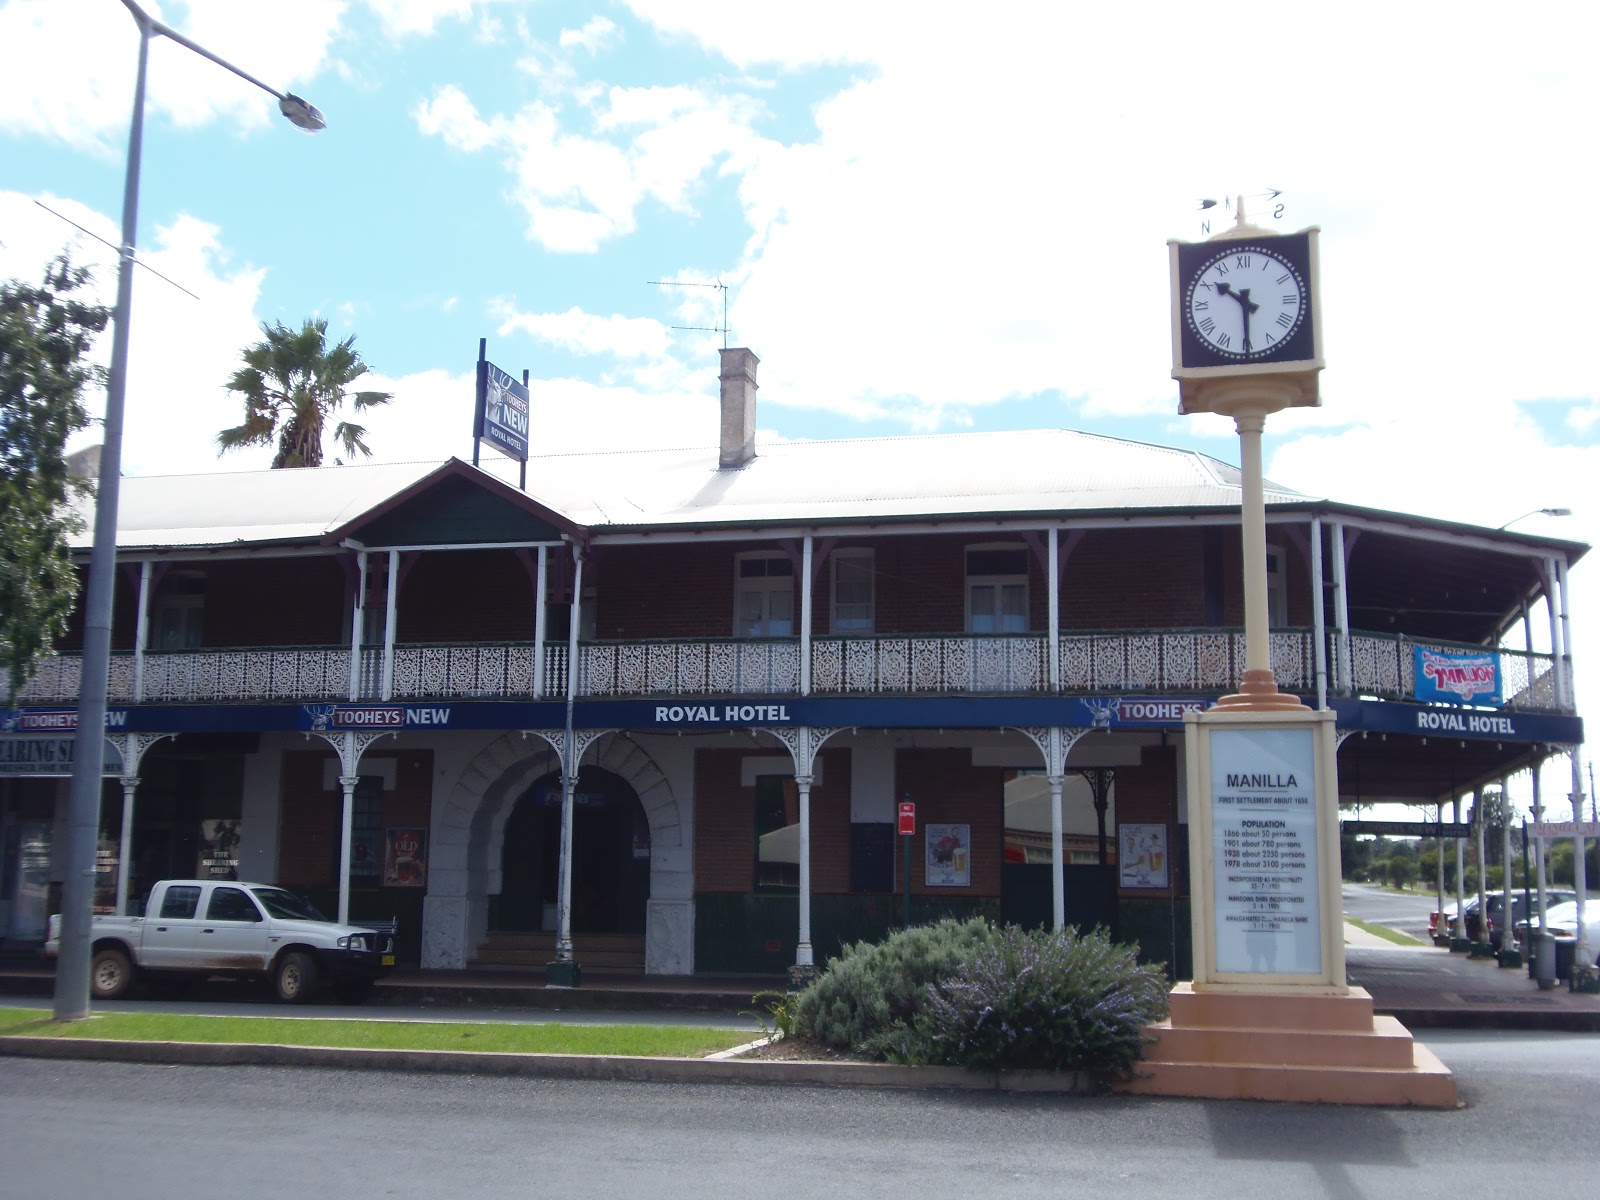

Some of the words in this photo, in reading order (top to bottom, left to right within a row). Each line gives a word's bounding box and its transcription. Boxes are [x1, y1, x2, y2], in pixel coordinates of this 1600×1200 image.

[1236, 255, 1251, 269] XII
[1262, 259, 1270, 271] I
[1214, 262, 1230, 277] XI
[1276, 273, 1291, 285] II
[1200, 280, 1214, 292] X
[1195, 300, 1209, 311] IX
[1282, 294, 1297, 305] III
[1199, 317, 1217, 337] VIII
[1217, 332, 1232, 349] VII
[1265, 332, 1276, 345] V
[506, 393, 527, 414] TOOHEYS
[503, 404, 528, 435] NEW
[491, 426, 506, 442] ROYAL
[506, 436, 522, 451] HOTEL
[336, 711, 400, 724] TOOHEYS
[405, 708, 450, 724] NEW
[655, 706, 720, 722] ROYAL
[725, 705, 791, 721] HOTEL
[1418, 711, 1467, 730] ROYAL
[1469, 716, 1516, 734] HOTEL
[1226, 774, 1298, 788] MANILLA
[1218, 796, 1235, 804] FIRST
[1241, 820, 1286, 828] POPULATION
[1224, 829, 1240, 837] 1866
[1271, 831, 1296, 839] persons
[395, 841, 418, 852] OLD
[1241, 840, 1260, 848] about
[1276, 842, 1302, 850] persons
[1224, 850, 1240, 858] 1938
[1241, 850, 1260, 858] about
[1262, 850, 1279, 858] 2250
[1224, 860, 1240, 868] 1978
[1242, 860, 1261, 868] about
[1271, 876, 1303, 884] MUNICIPALITY
